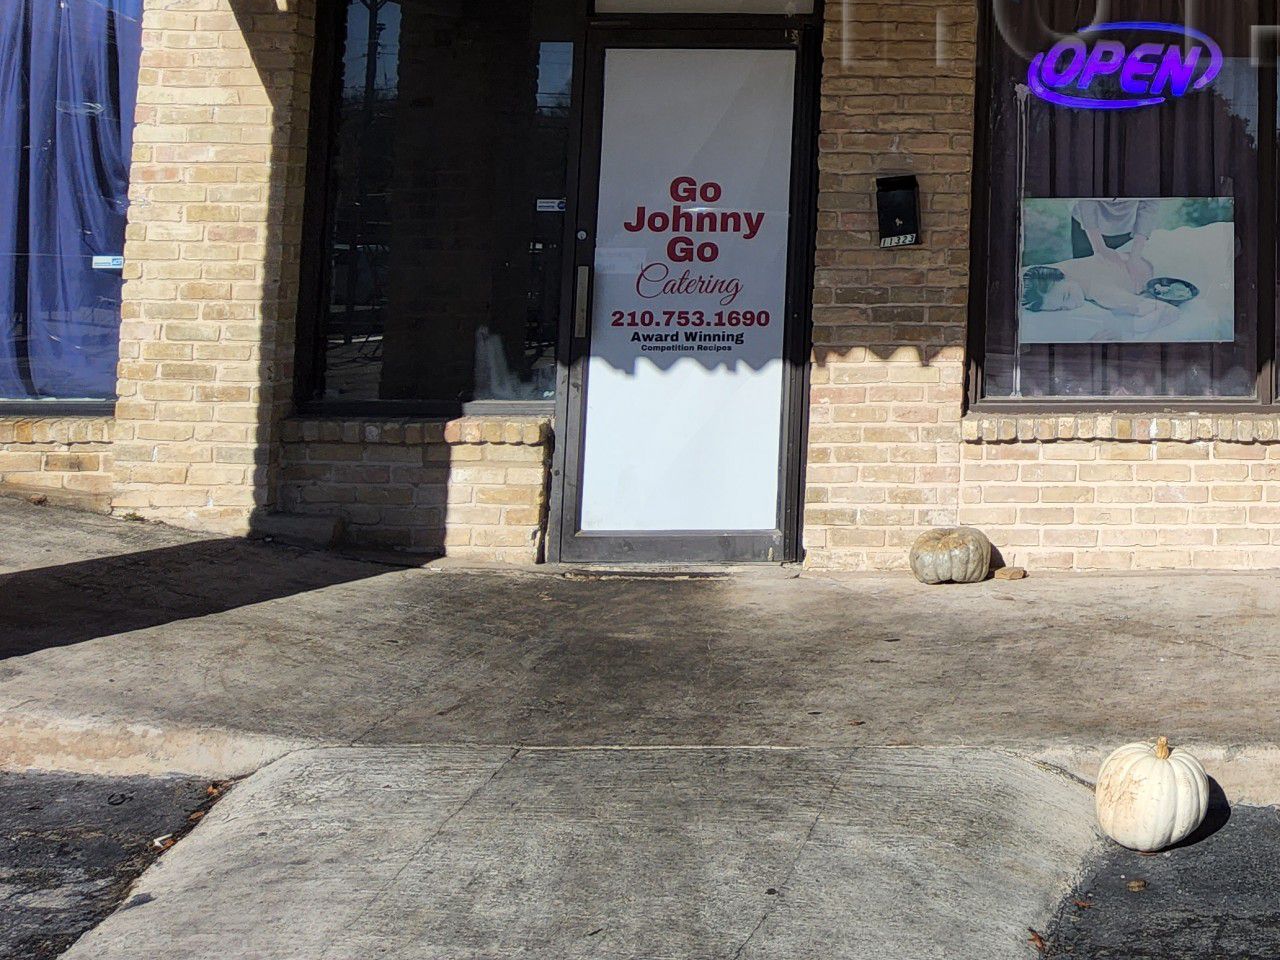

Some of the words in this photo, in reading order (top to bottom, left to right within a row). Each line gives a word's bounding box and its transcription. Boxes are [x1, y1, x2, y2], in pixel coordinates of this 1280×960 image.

[1040, 37, 1203, 96] OPEN
[669, 176, 722, 202] Go
[623, 205, 765, 240] Johnny
[666, 236, 719, 263] Go
[636, 262, 744, 306] Catering
[611, 310, 770, 327] 210.753.1690
[630, 331, 679, 342] Award
[684, 331, 744, 344] Winning
[641, 344, 694, 352] Competition
[697, 344, 732, 352] Recipes
